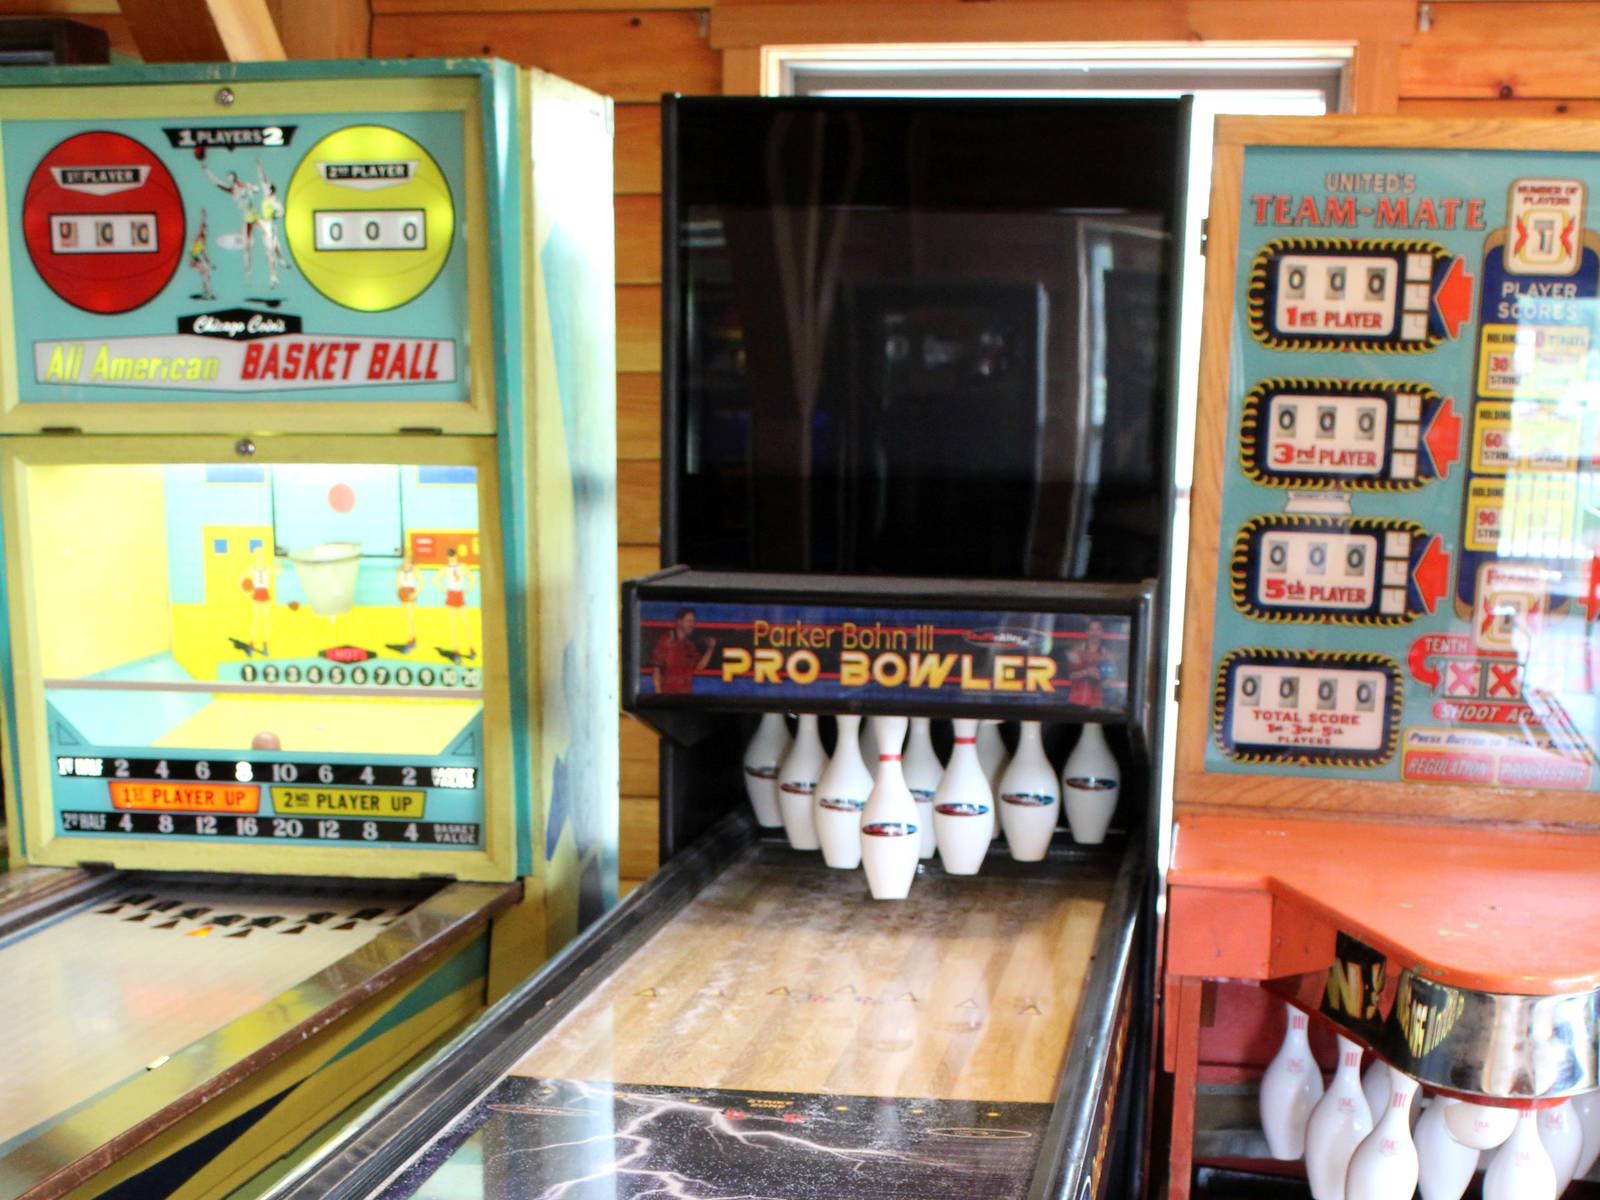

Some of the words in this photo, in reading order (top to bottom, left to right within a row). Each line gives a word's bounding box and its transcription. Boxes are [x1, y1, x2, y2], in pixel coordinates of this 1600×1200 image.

[197, 129, 262, 145] PLAYERS
[262, 127, 284, 147] 2
[83, 169, 135, 183] PLAYER
[352, 164, 406, 178] PLAYER
[1325, 172, 1417, 194] UNITED'S
[1523, 196, 1571, 206] PLAYERS
[1250, 194, 1488, 231] TEAM-MATE
[1502, 281, 1578, 299] PLAYER
[1324, 310, 1383, 329] PLAYER
[1497, 301, 1578, 321] SCORES
[193, 315, 245, 337] Chicago
[45, 343, 84, 382] All
[91, 344, 219, 382] American
[241, 341, 361, 381] BASKET
[366, 342, 439, 381] BALL
[1272, 443, 1317, 465] 3rd
[1319, 448, 1378, 467] PLAYER
[1265, 578, 1306, 600] 5th
[1310, 585, 1367, 603] PLAYER
[753, 619, 836, 649] Parker
[842, 621, 908, 651] Bohn
[916, 624, 935, 652] III
[1424, 638, 1469, 652] TENTH
[721, 647, 821, 685] PRO
[840, 650, 1057, 693] BOWLER
[1252, 709, 1303, 724] TOTAL
[1308, 712, 1361, 727] SCORE
[1440, 702, 1501, 721] SHOOT
[1277, 735, 1332, 746] PLAYERS
[115, 759, 130, 777] 2
[155, 760, 170, 779] 4
[195, 761, 211, 780] 6
[234, 760, 254, 782] 8
[272, 763, 298, 783] 10
[318, 765, 334, 784] 6
[360, 766, 375, 785] 4
[401, 767, 417, 786] 2
[1407, 756, 1489, 779] REGULATION
[153, 790, 214, 807] PLAYER
[225, 791, 247, 807] UP
[316, 794, 381, 811] PLAYER
[391, 796, 413, 811] UP
[119, 813, 134, 832] 4
[158, 814, 174, 834] 8
[196, 815, 218, 835] 12
[236, 817, 259, 837] 16
[272, 819, 304, 838] 20
[318, 820, 341, 839] 12
[362, 822, 379, 841] 8
[403, 823, 419, 842] 4
[433, 823, 476, 834] BASKET
[434, 832, 476, 844] VALUE
